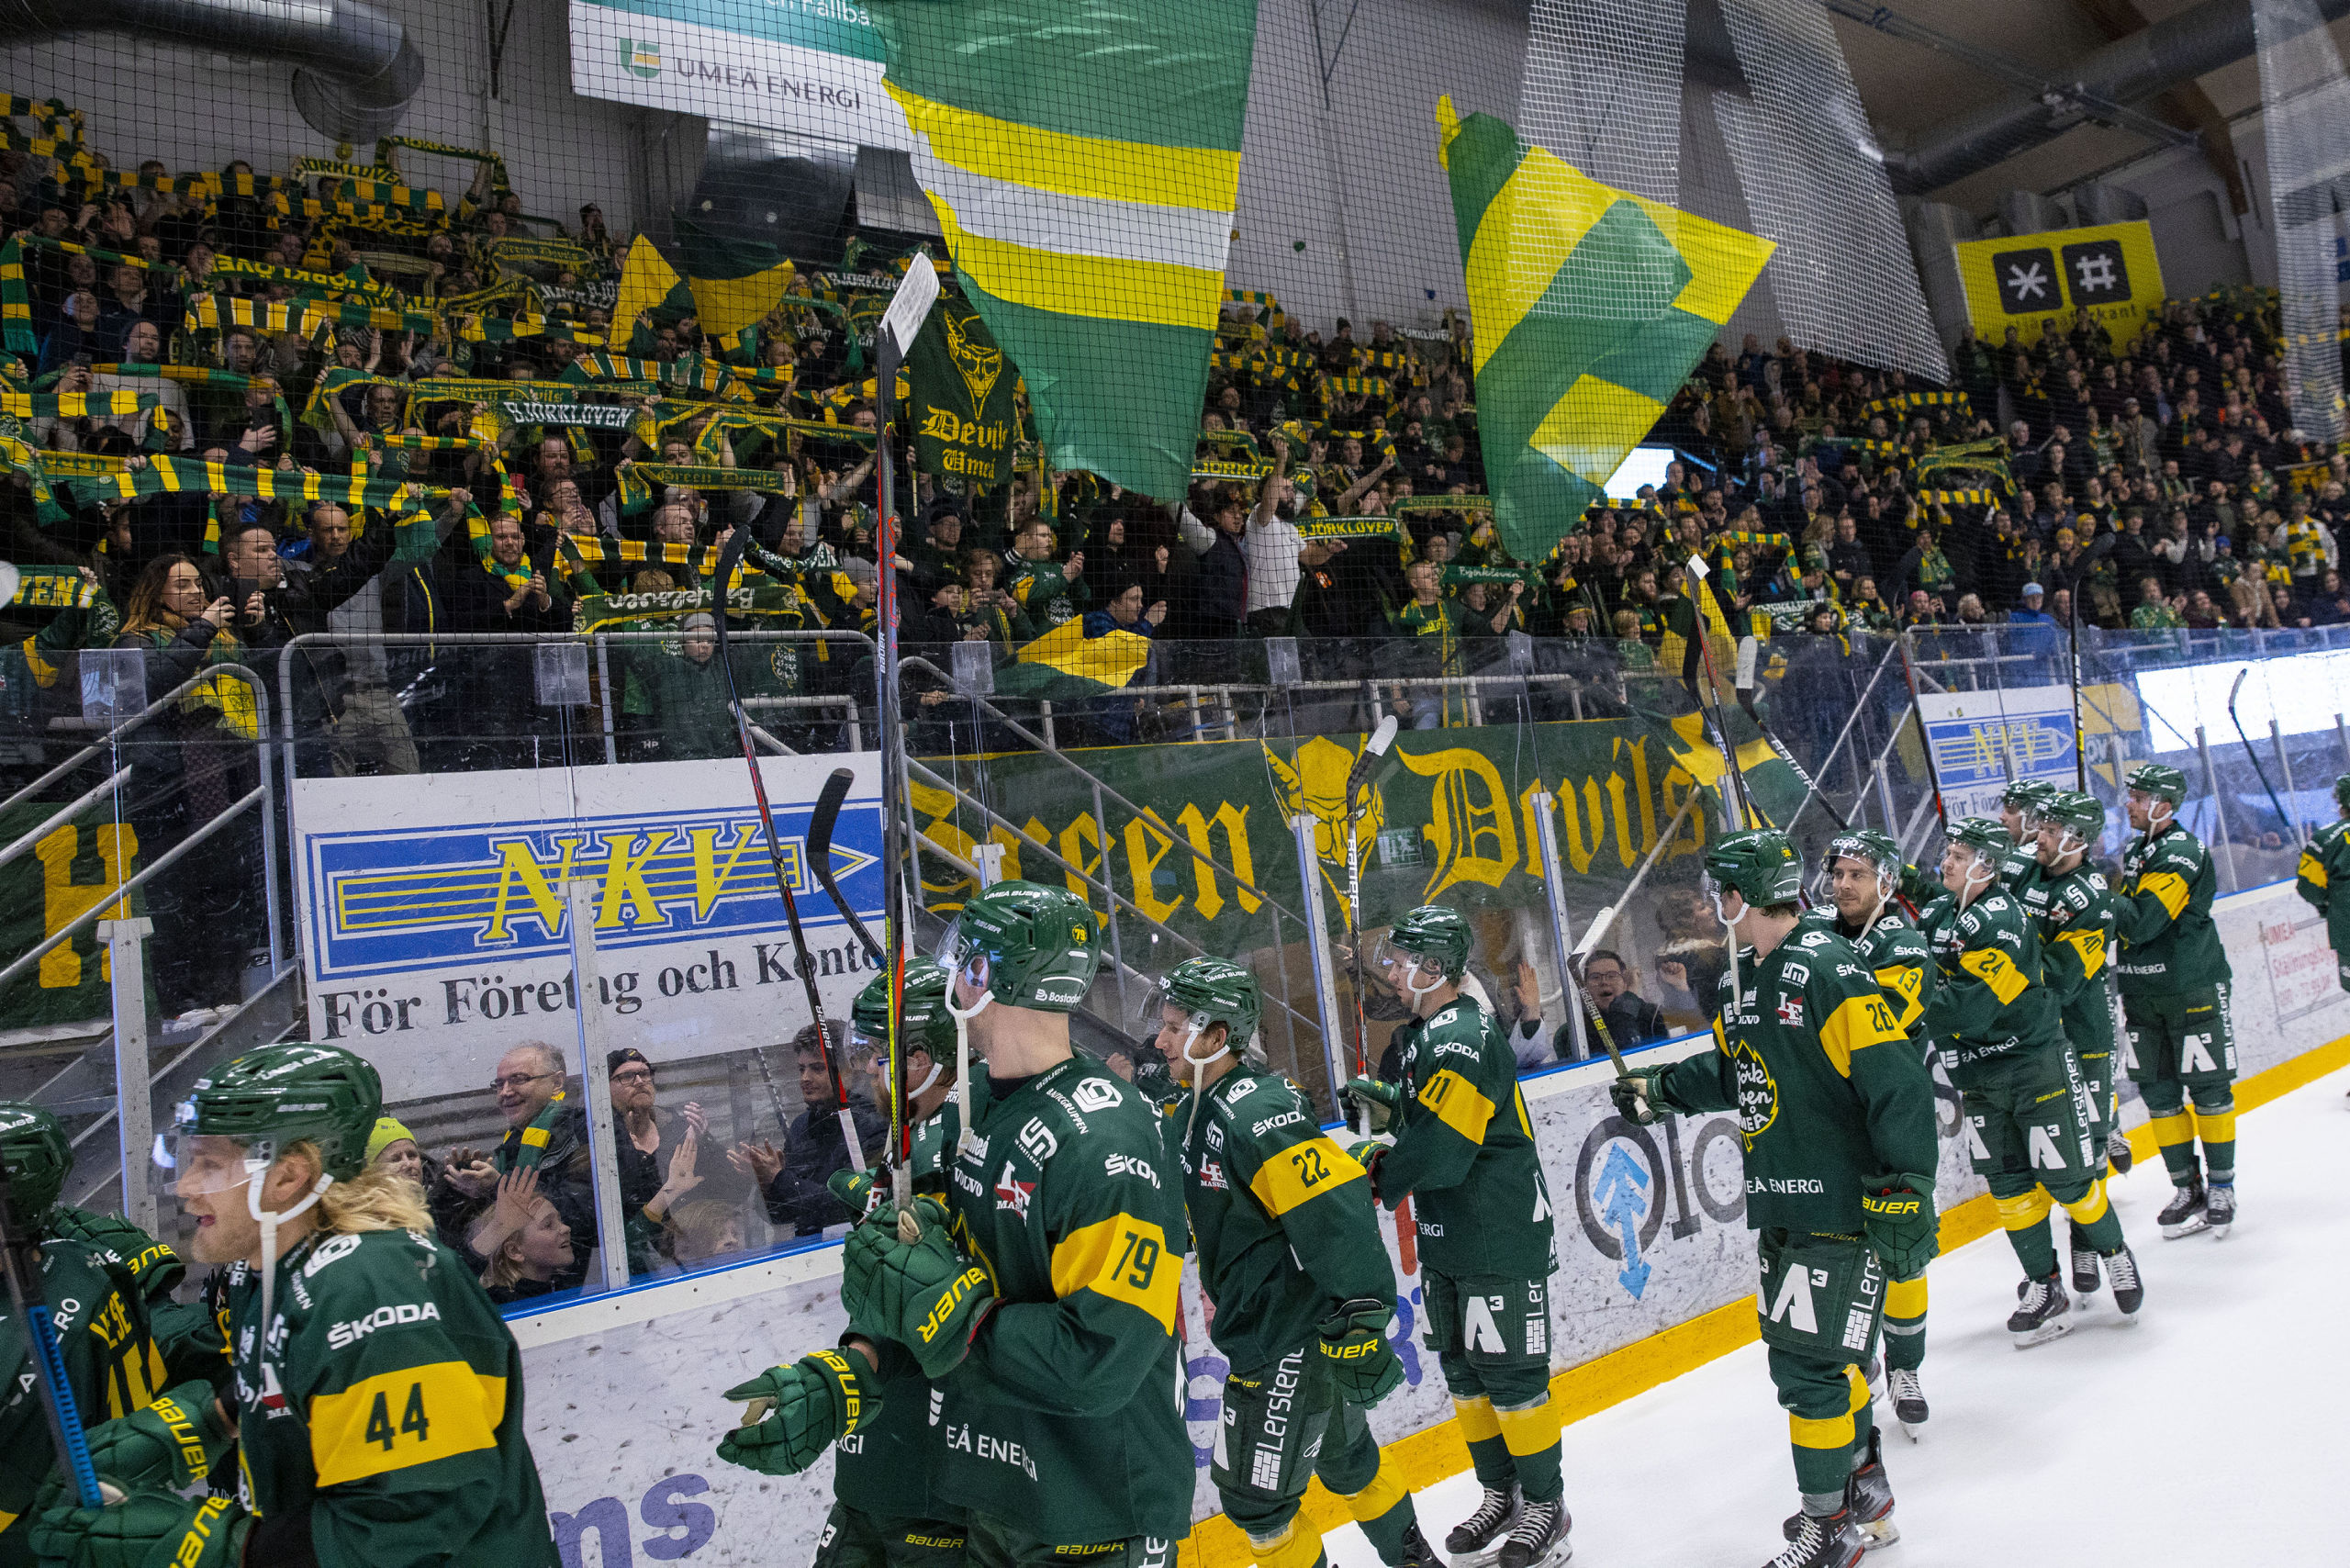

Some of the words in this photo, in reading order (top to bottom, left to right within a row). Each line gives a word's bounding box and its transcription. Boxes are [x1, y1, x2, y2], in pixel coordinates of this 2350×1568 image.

[677, 57, 758, 90] UMEÅ
[767, 76, 861, 110] ENERGI
[503, 401, 634, 429] BJÖRKLÖVEN
[604, 586, 755, 610] Bjrklöven
[1770, 738, 1818, 791] BAUER
[482, 824, 759, 942] NKV
[1347, 838, 1360, 909] BAUER
[1074, 927, 1088, 942] 79
[1893, 945, 1929, 958] ŠKOD
[1977, 952, 2007, 979] 24
[319, 988, 421, 1040] För
[658, 949, 738, 998] och
[753, 936, 883, 985] Konto
[814, 1004, 834, 1049] BAUER
[1864, 1002, 1896, 1033] 26
[1433, 1041, 1481, 1063] ŠKODA
[1425, 1075, 1451, 1104] 11
[954, 1166, 984, 1198] VOLVO
[1291, 1148, 1332, 1189] 22
[1769, 1178, 1825, 1194] ENERGI
[1862, 1195, 1921, 1215] AUER
[1419, 1223, 1445, 1238] ERGI
[1110, 1230, 1161, 1291] 79
[326, 1301, 442, 1351] ŠKODA
[1318, 1337, 1379, 1360] AUER
[806, 1350, 861, 1438] BAUER
[364, 1382, 431, 1452] 44
[148, 1396, 209, 1484] BAUER
[977, 1433, 1038, 1483] ENERGI
[904, 1533, 965, 1550] BAUER
